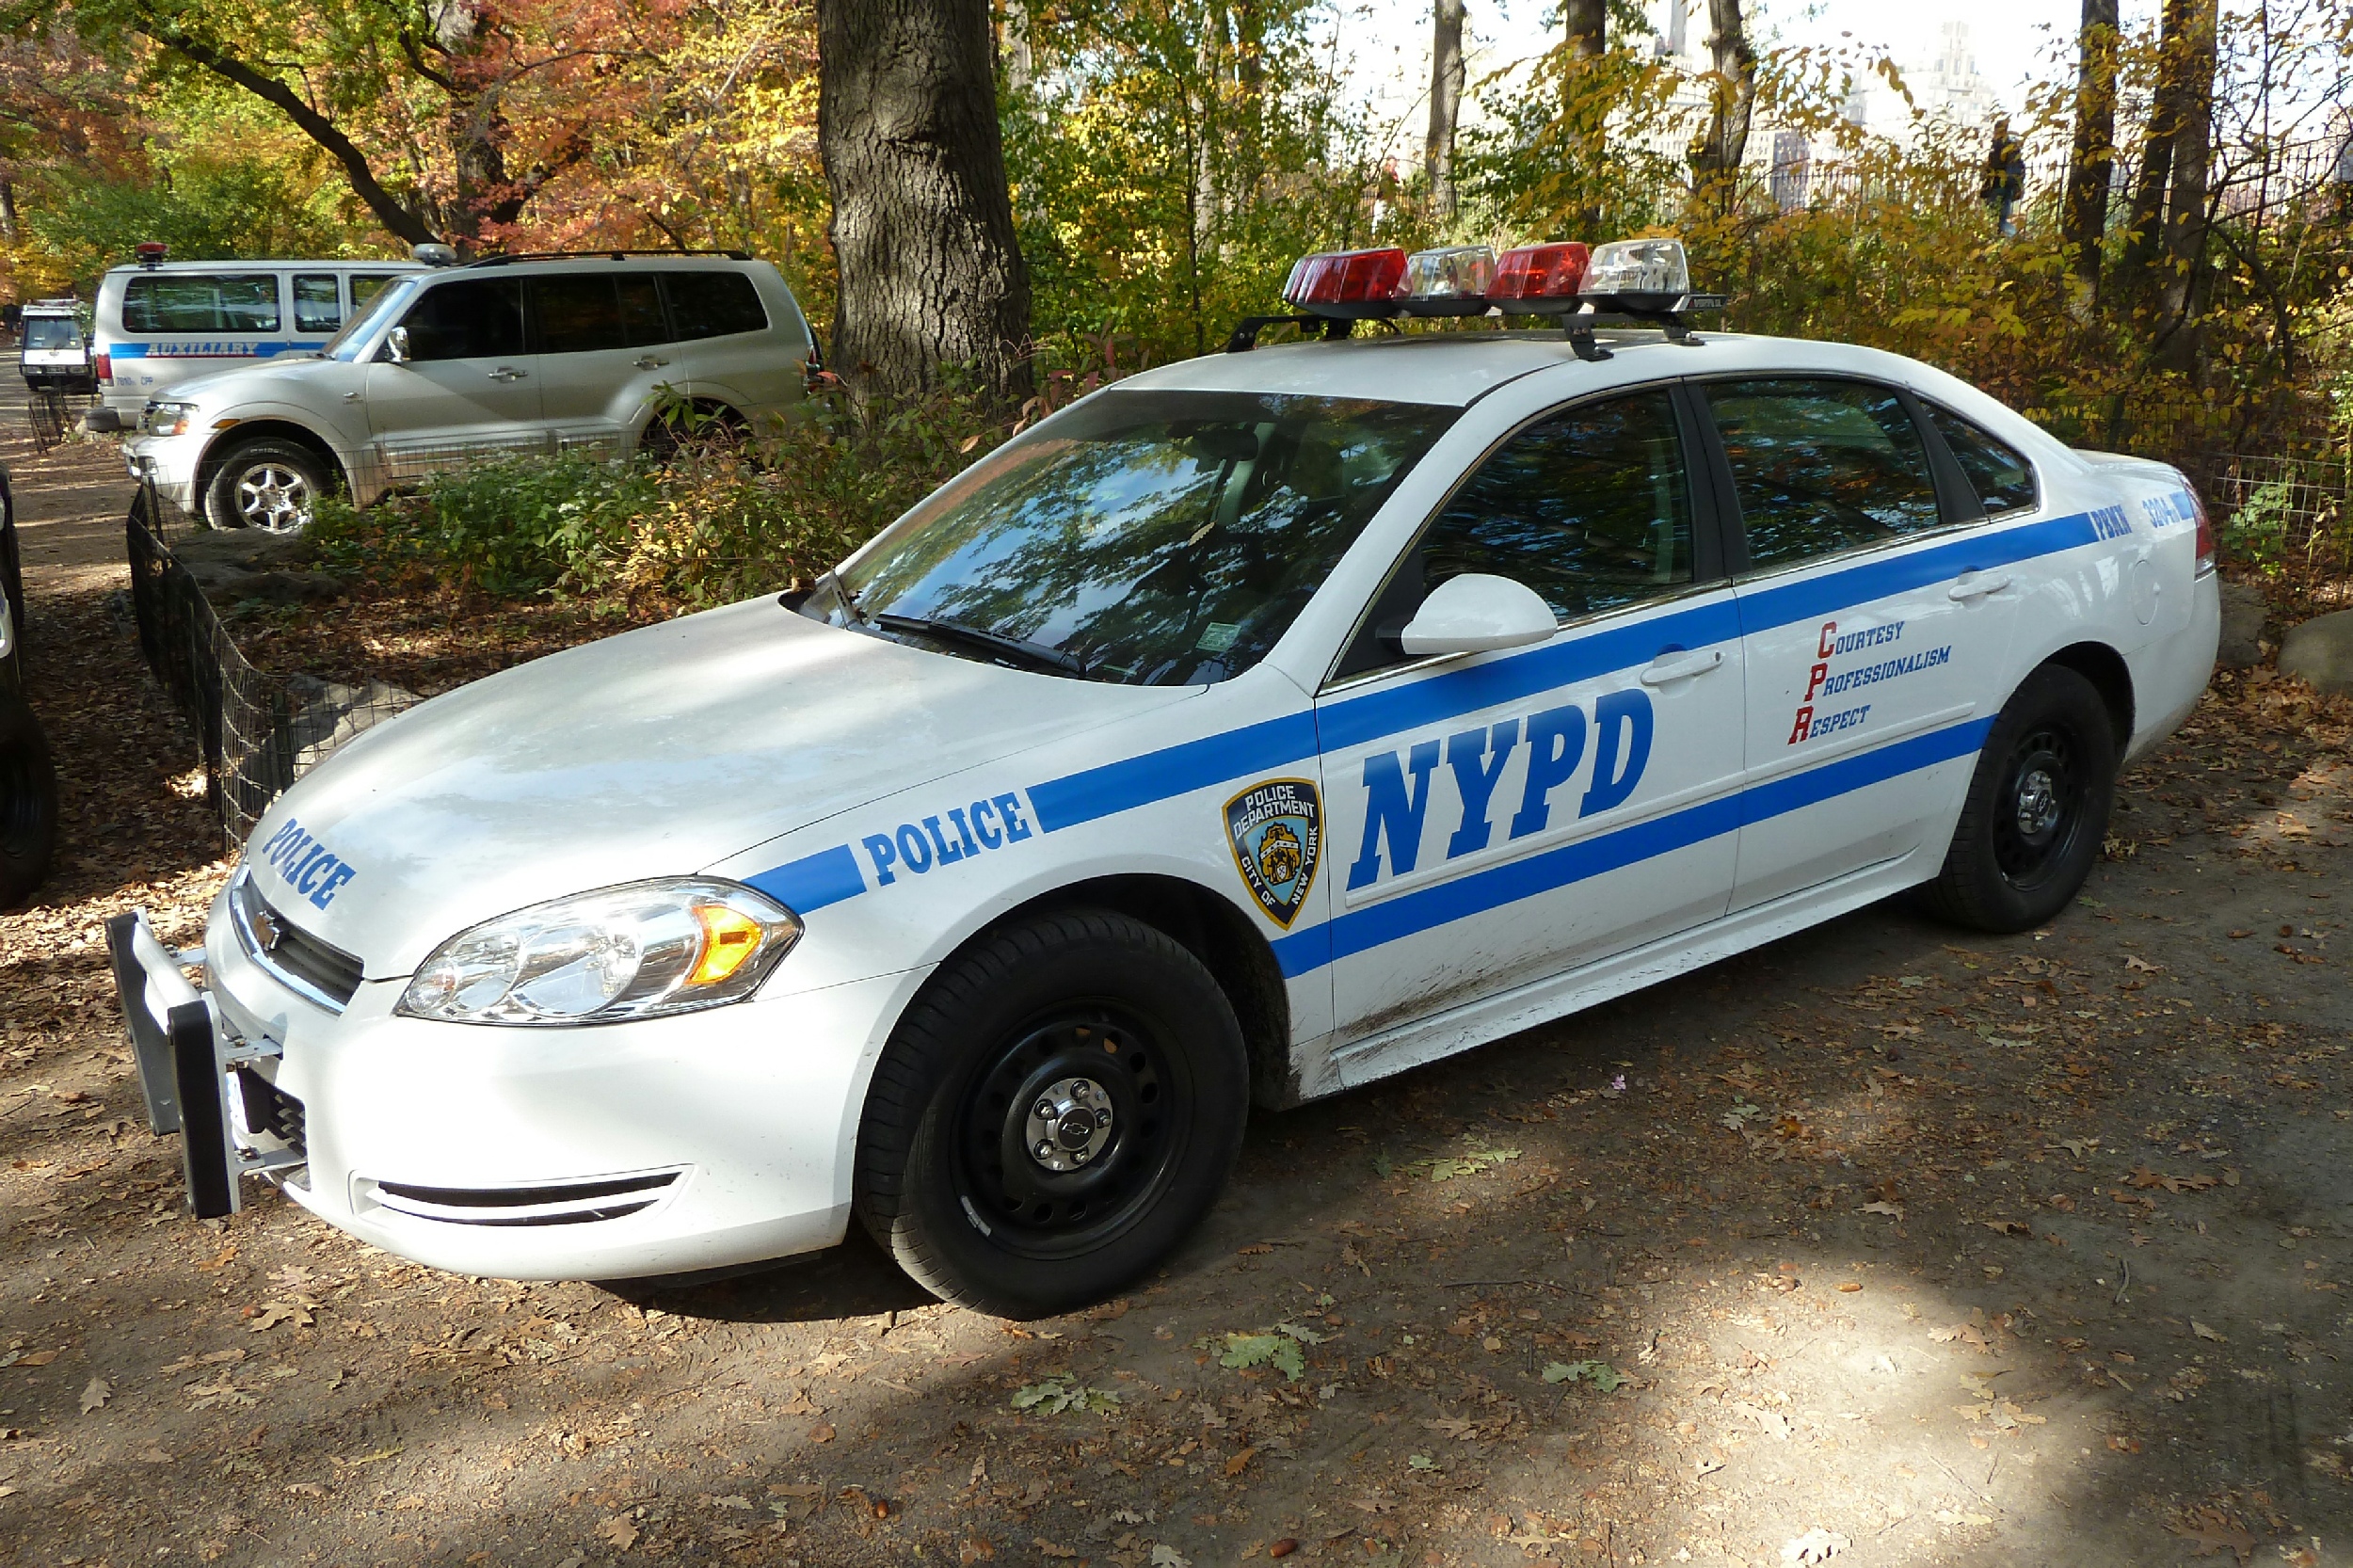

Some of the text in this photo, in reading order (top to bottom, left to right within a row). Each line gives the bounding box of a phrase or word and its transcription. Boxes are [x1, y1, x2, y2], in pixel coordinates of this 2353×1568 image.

[146, 343, 259, 356] AUXILIARY
[1817, 621, 1905, 660] COURTESY
[1803, 645, 1952, 702] PROFESSIONALISM
[1787, 704, 1871, 745] RESPECT
[1244, 785, 1296, 811] POLICE
[1346, 688, 1654, 891] NYPD
[861, 792, 1032, 887] POLICE
[1233, 800, 1315, 840] DEPARTMENT
[262, 817, 357, 911] POLICE
[1241, 825, 1319, 906] CITY OF NEW YORK
